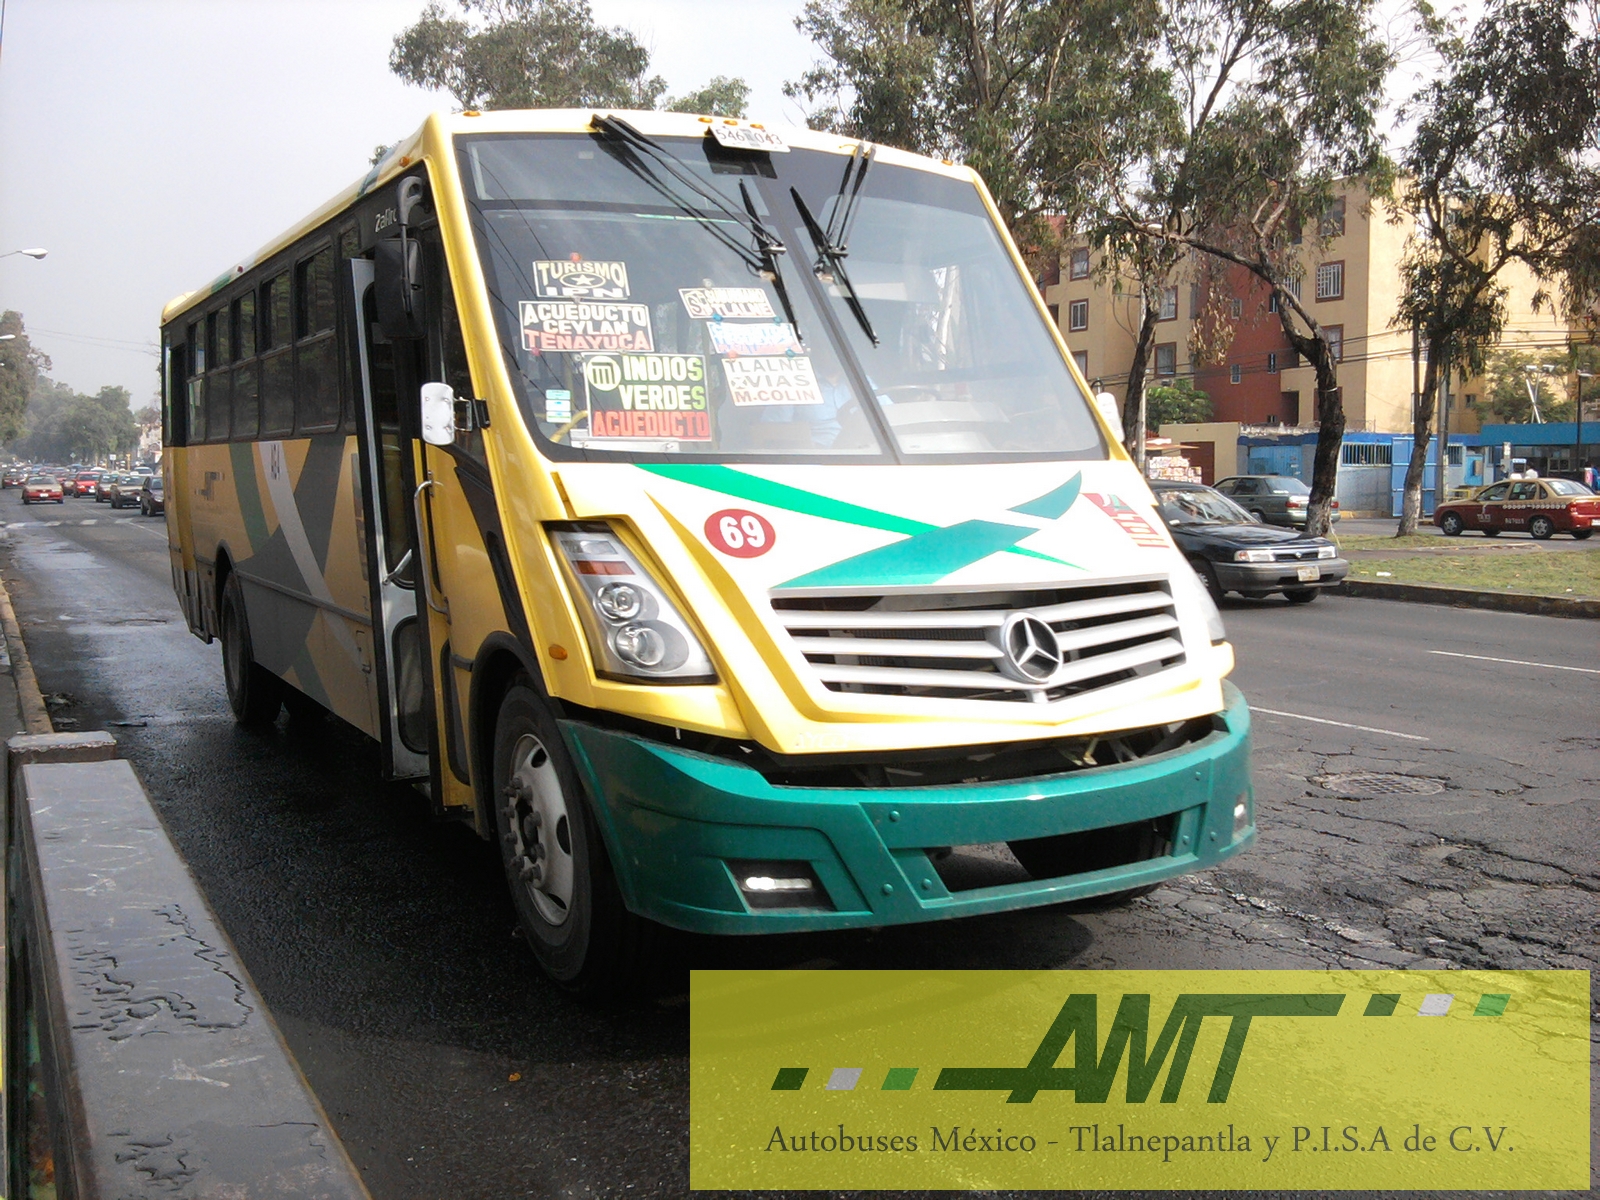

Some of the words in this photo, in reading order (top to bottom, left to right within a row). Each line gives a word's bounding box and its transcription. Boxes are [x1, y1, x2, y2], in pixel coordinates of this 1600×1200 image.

[537, 261, 625, 288] TURISMO
[545, 286, 625, 299] IPN
[523, 303, 648, 328] ACUEDUCTO
[542, 319, 629, 335] CEYLAN
[524, 328, 651, 350] TENAYUCA
[621, 355, 704, 382] INDIOS
[724, 358, 807, 373] TLALNE
[744, 374, 812, 388] VIAS
[618, 384, 706, 411] VERDES
[591, 409, 711, 438] ACUEDUCTO
[718, 514, 767, 550] 69
